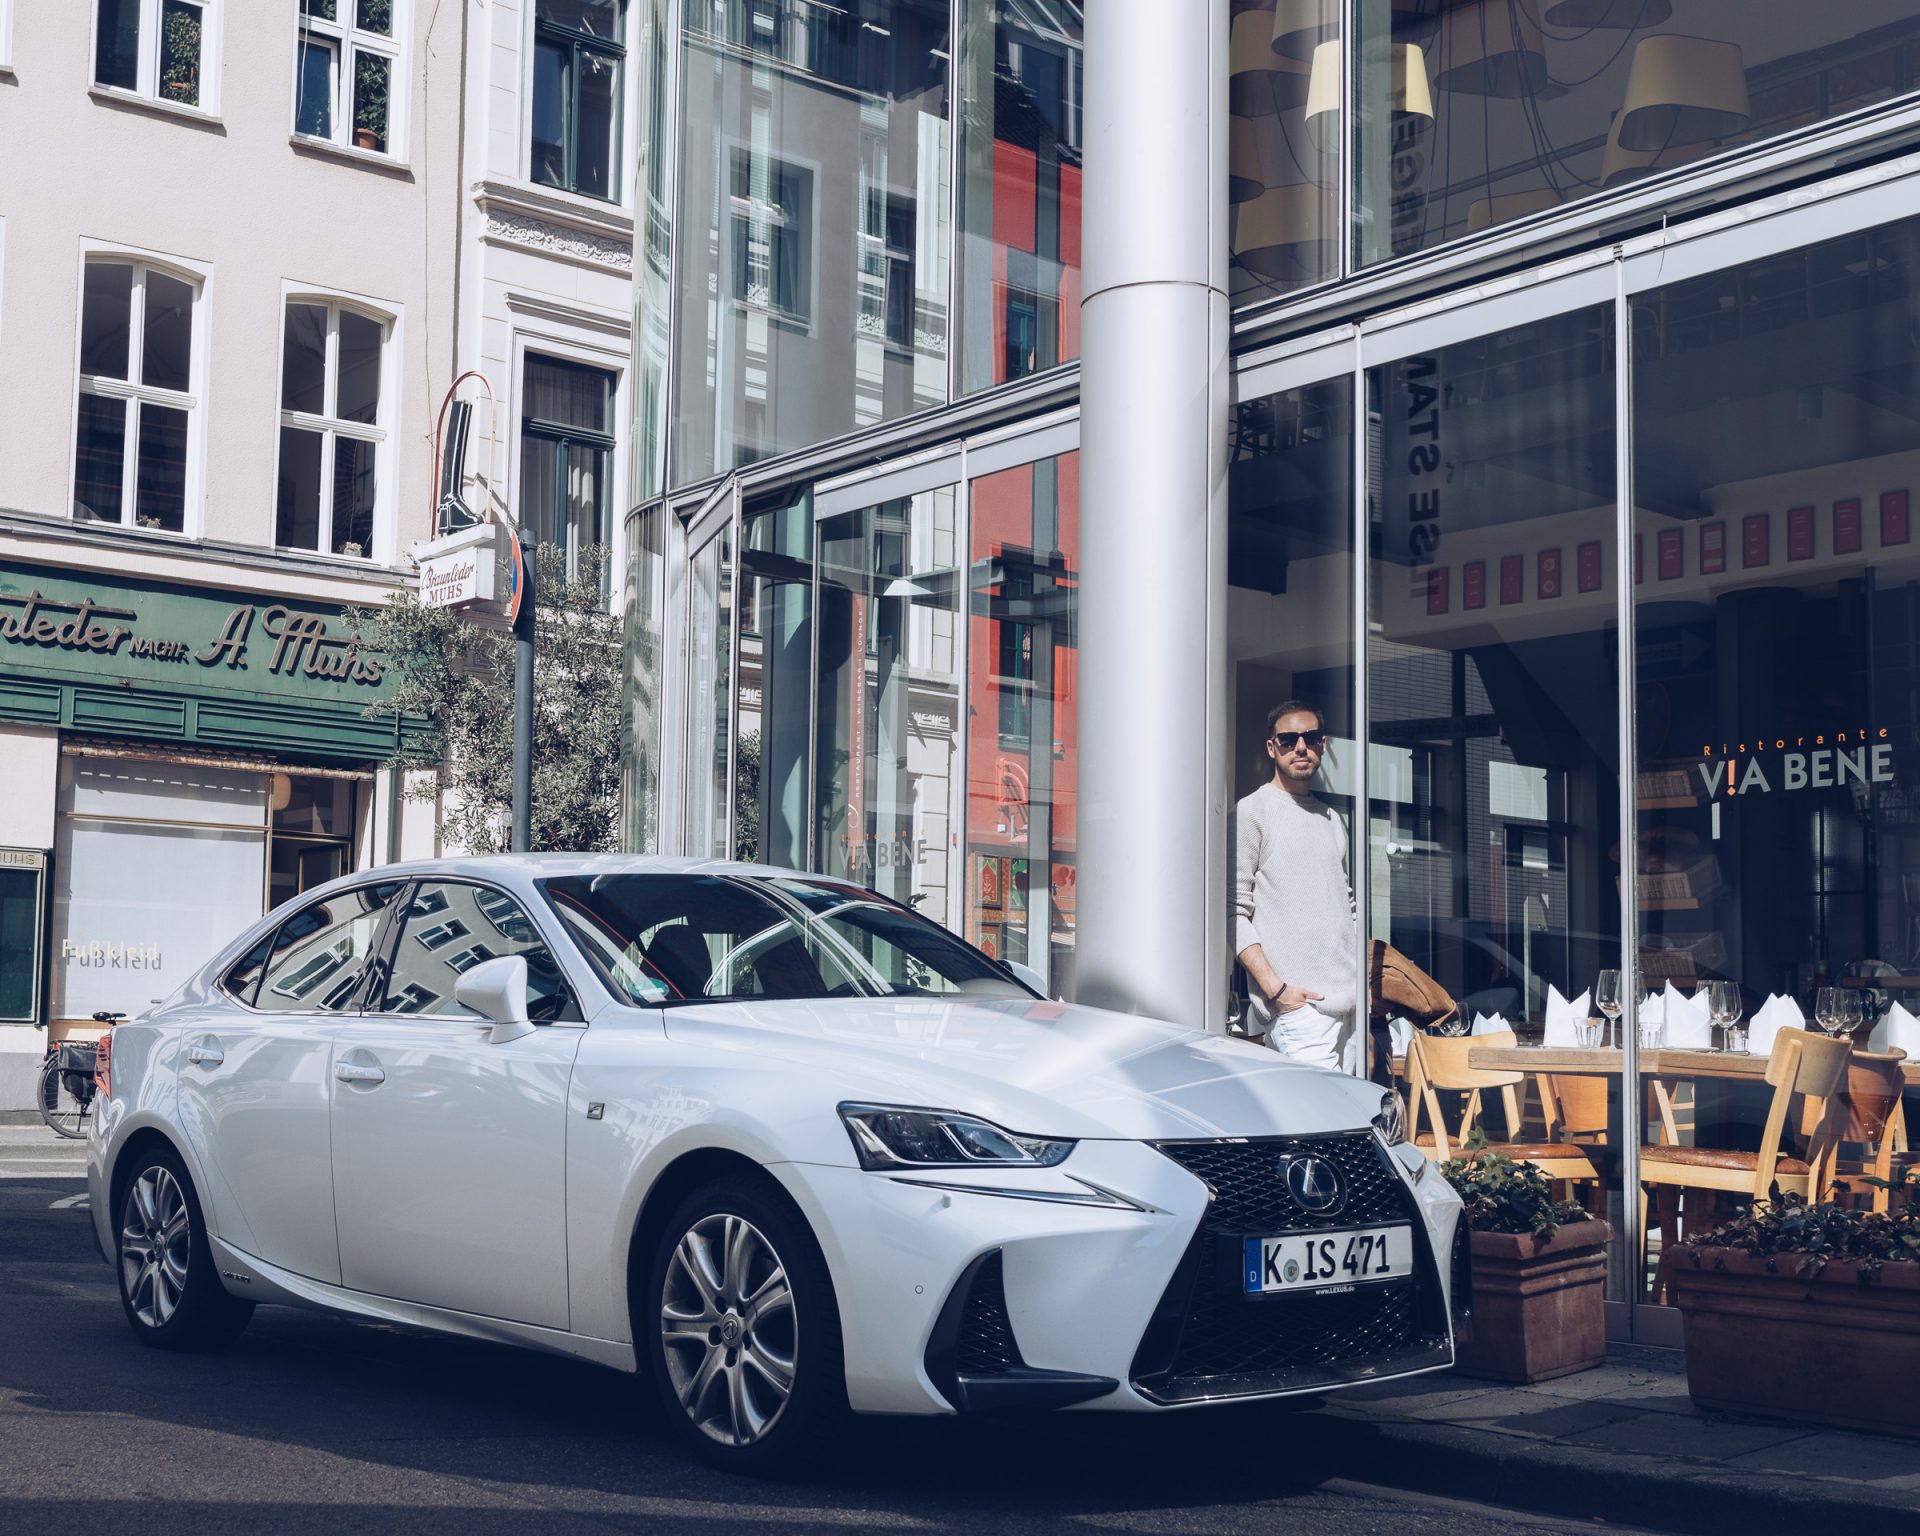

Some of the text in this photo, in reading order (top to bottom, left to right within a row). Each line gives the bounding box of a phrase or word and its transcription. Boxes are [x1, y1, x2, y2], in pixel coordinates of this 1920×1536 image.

[429, 583, 463, 603] MUHS
[1703, 727, 1888, 756] Ristorante
[1784, 743, 1895, 791] BENE
[0, 852, 35, 865] UHS
[878, 839, 927, 868] BENE
[1264, 1234, 1391, 1285] K IS 471
